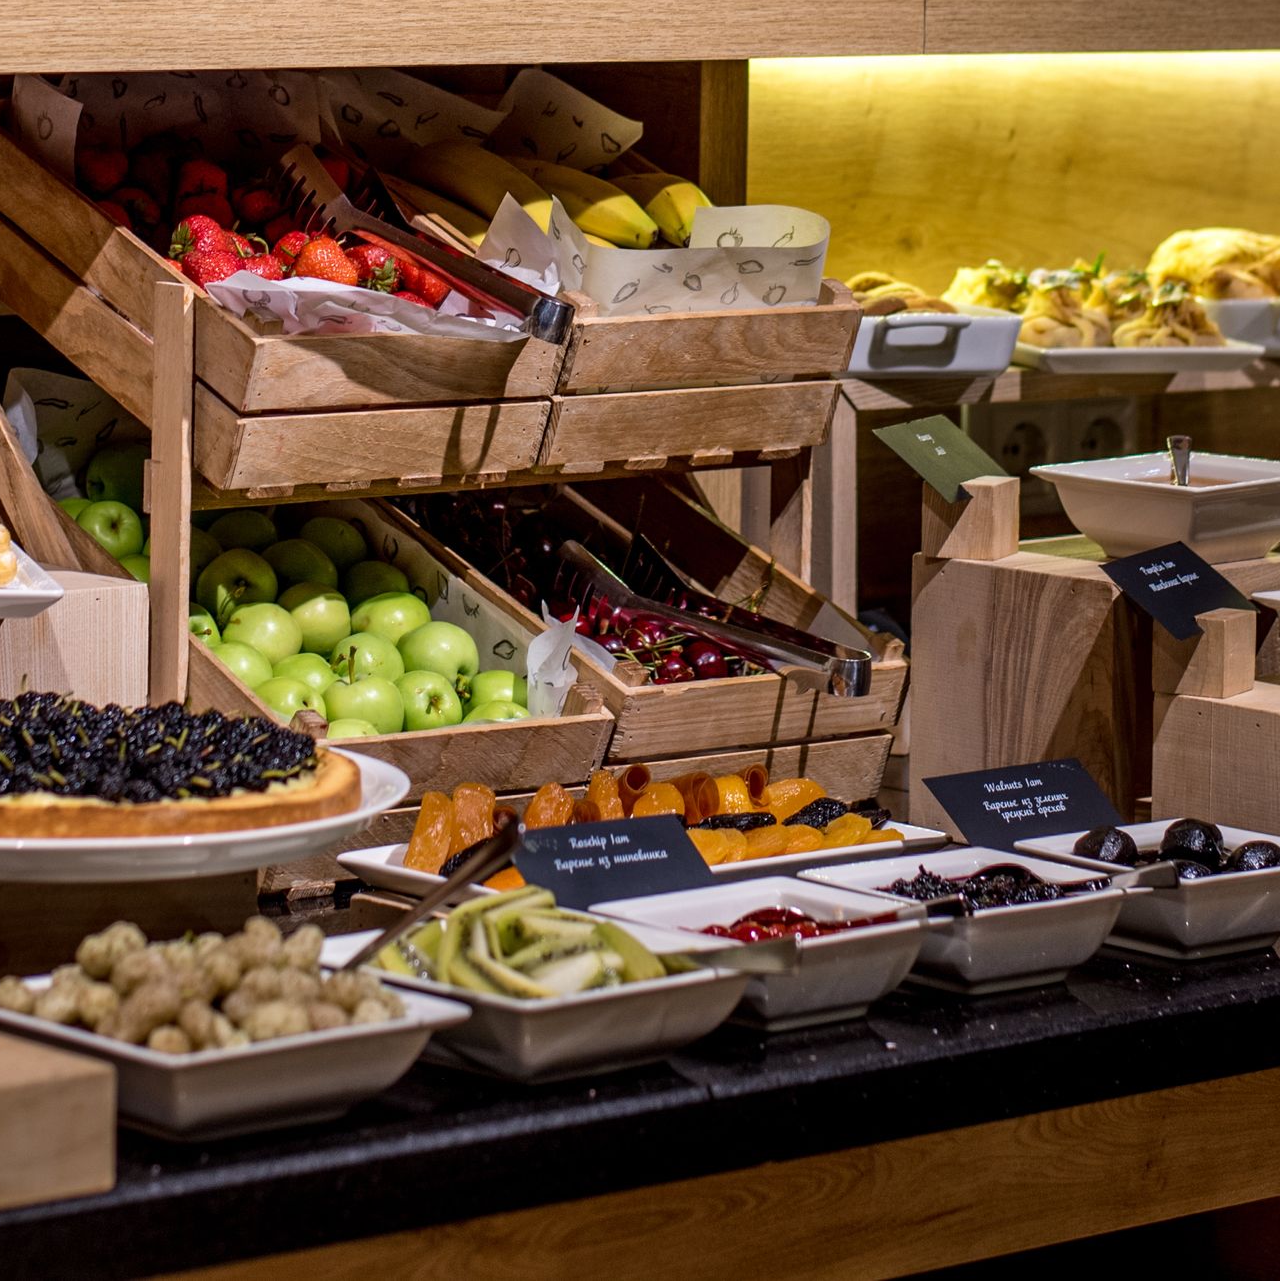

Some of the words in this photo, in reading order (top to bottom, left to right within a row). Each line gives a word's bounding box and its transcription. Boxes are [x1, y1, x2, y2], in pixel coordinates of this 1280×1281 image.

[983, 779, 1023, 794] Walnuts
[983, 800, 1019, 814] Варенье
[1022, 798, 1033, 809] из
[1035, 792, 1069, 808] зеленых
[1001, 808, 1036, 824] грецких
[1037, 801, 1067, 818] орехов
[568, 834, 607, 850] Rosehip
[554, 857, 595, 874] Варенье
[598, 856, 611, 869] из
[613, 848, 669, 865] шиповника
